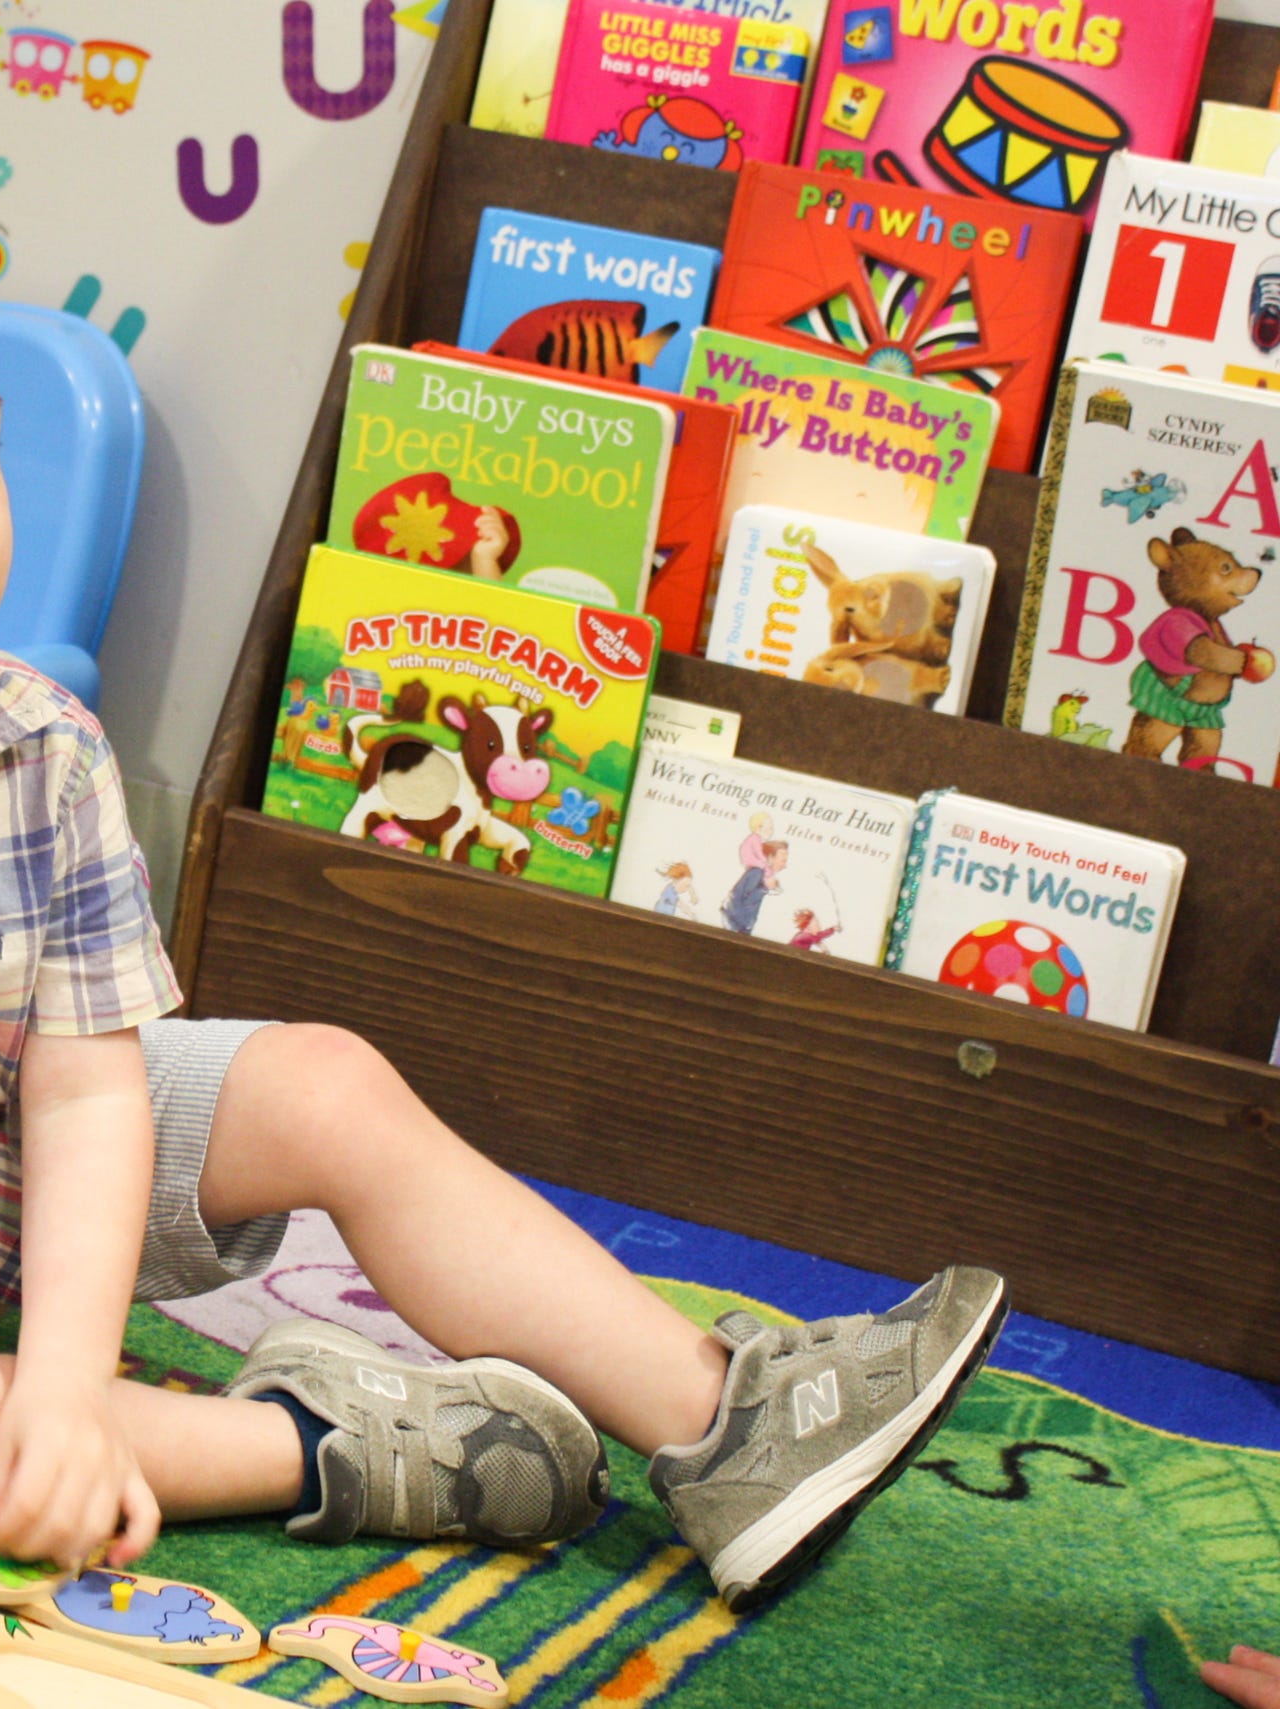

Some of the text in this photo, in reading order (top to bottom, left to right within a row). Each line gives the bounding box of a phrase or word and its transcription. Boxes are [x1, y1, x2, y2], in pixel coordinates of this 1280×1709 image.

[600, 12, 722, 47] LITTLE MISS
[603, 33, 710, 68] GIGGLES
[898, 0, 1122, 67] Words
[601, 54, 632, 74] has
[636, 63, 649, 76] a
[653, 65, 710, 88] giggle
[796, 185, 1031, 259] Pinwheel
[1124, 184, 1177, 224] My
[1182, 193, 1257, 233] Little
[490, 225, 696, 298] first words
[1149, 240, 1186, 328] 1
[418, 374, 634, 454] Baby says
[706, 350, 971, 441] Where Is Baby's
[1165, 414, 1225, 436] CYNDY
[351, 414, 643, 509] peekaboo!
[800, 415, 966, 485] Button?
[1196, 439, 1280, 538] A
[1049, 568, 1136, 665] B
[347, 614, 600, 707] AT THE FARM
[389, 654, 544, 704] with my playful pals
[594, 637, 621, 664] BOOK
[307, 735, 341, 754] birds
[643, 788, 738, 821] Michael Rosen
[649, 759, 896, 837] We're Going on a Bear Hunt
[535, 821, 593, 859] butterfly
[785, 824, 823, 843] Helen
[979, 831, 1020, 854] Baby
[1024, 841, 1071, 865] Touch
[1075, 856, 1108, 875] and
[1112, 864, 1148, 885] Feel
[931, 843, 1156, 934] First Words
[358, 1366, 407, 1401] N
[794, 1369, 840, 1439] N
